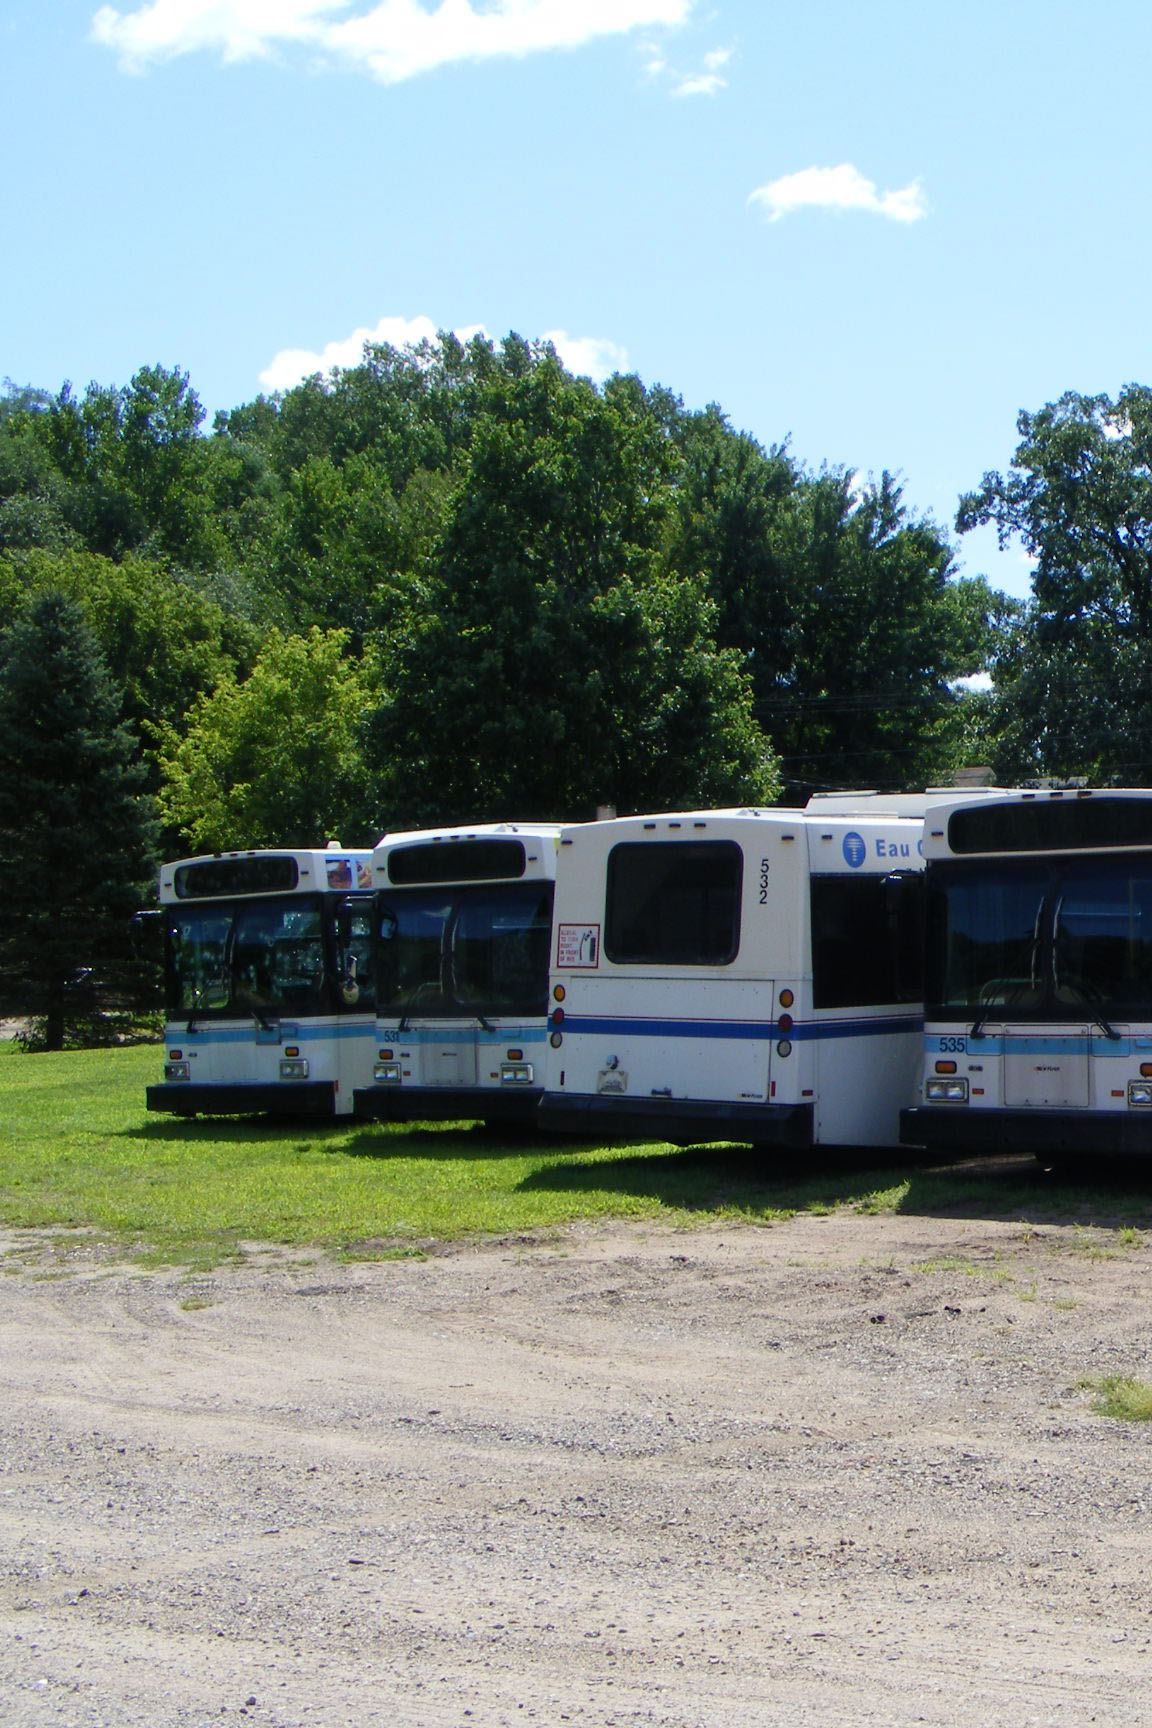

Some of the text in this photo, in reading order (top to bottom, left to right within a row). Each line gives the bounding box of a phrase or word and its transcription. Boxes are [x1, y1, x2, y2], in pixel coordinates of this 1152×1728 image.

[875, 839, 909, 857] Eau
[759, 858, 770, 905] 532
[938, 1037, 965, 1052] 535
